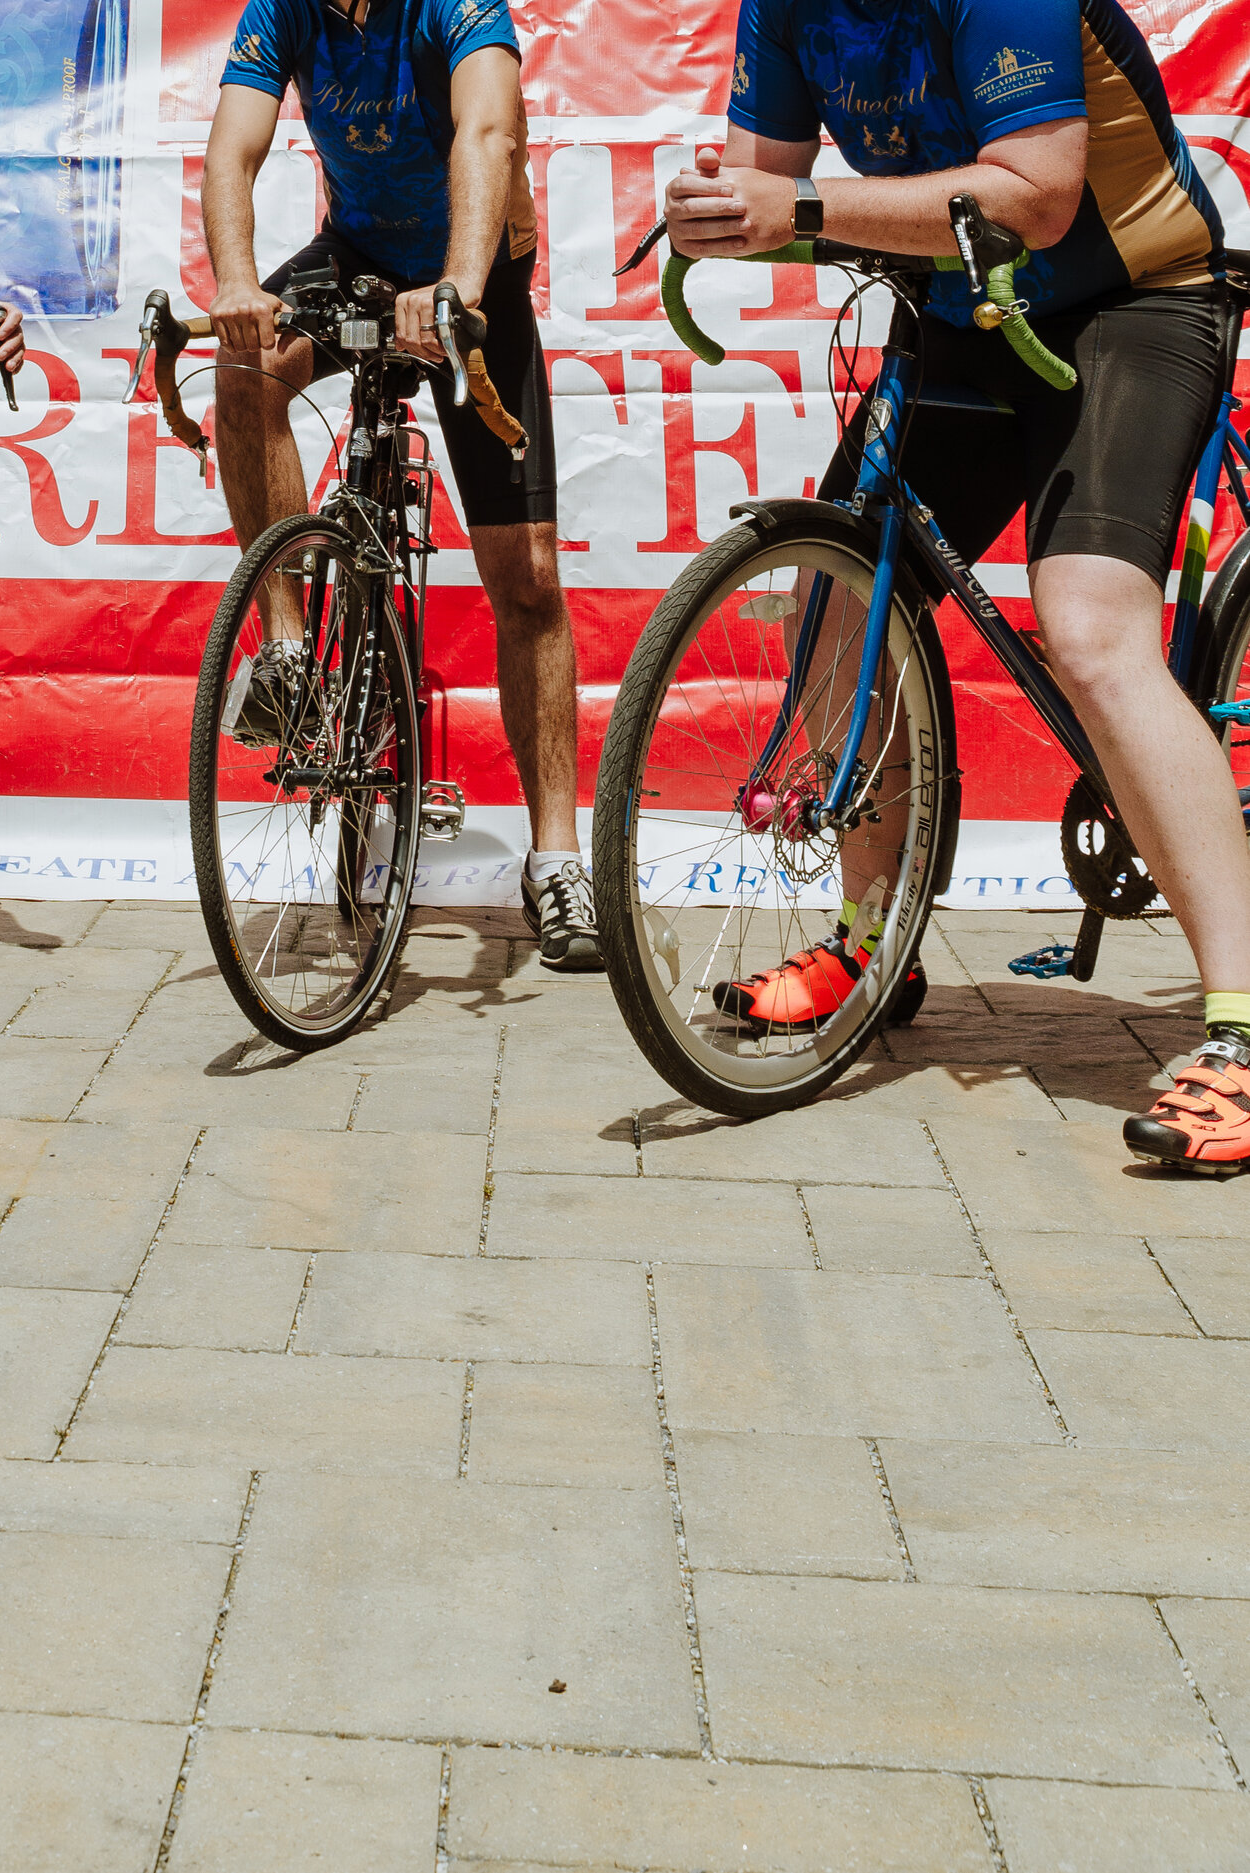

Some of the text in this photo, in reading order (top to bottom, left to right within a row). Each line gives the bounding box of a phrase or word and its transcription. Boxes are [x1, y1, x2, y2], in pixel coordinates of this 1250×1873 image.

[62, 56, 77, 102] PROOF
[974, 66, 1054, 100] PHILADELPHIA
[987, 76, 1041, 99] DISTILLING
[358, 631, 375, 709] SURLY
